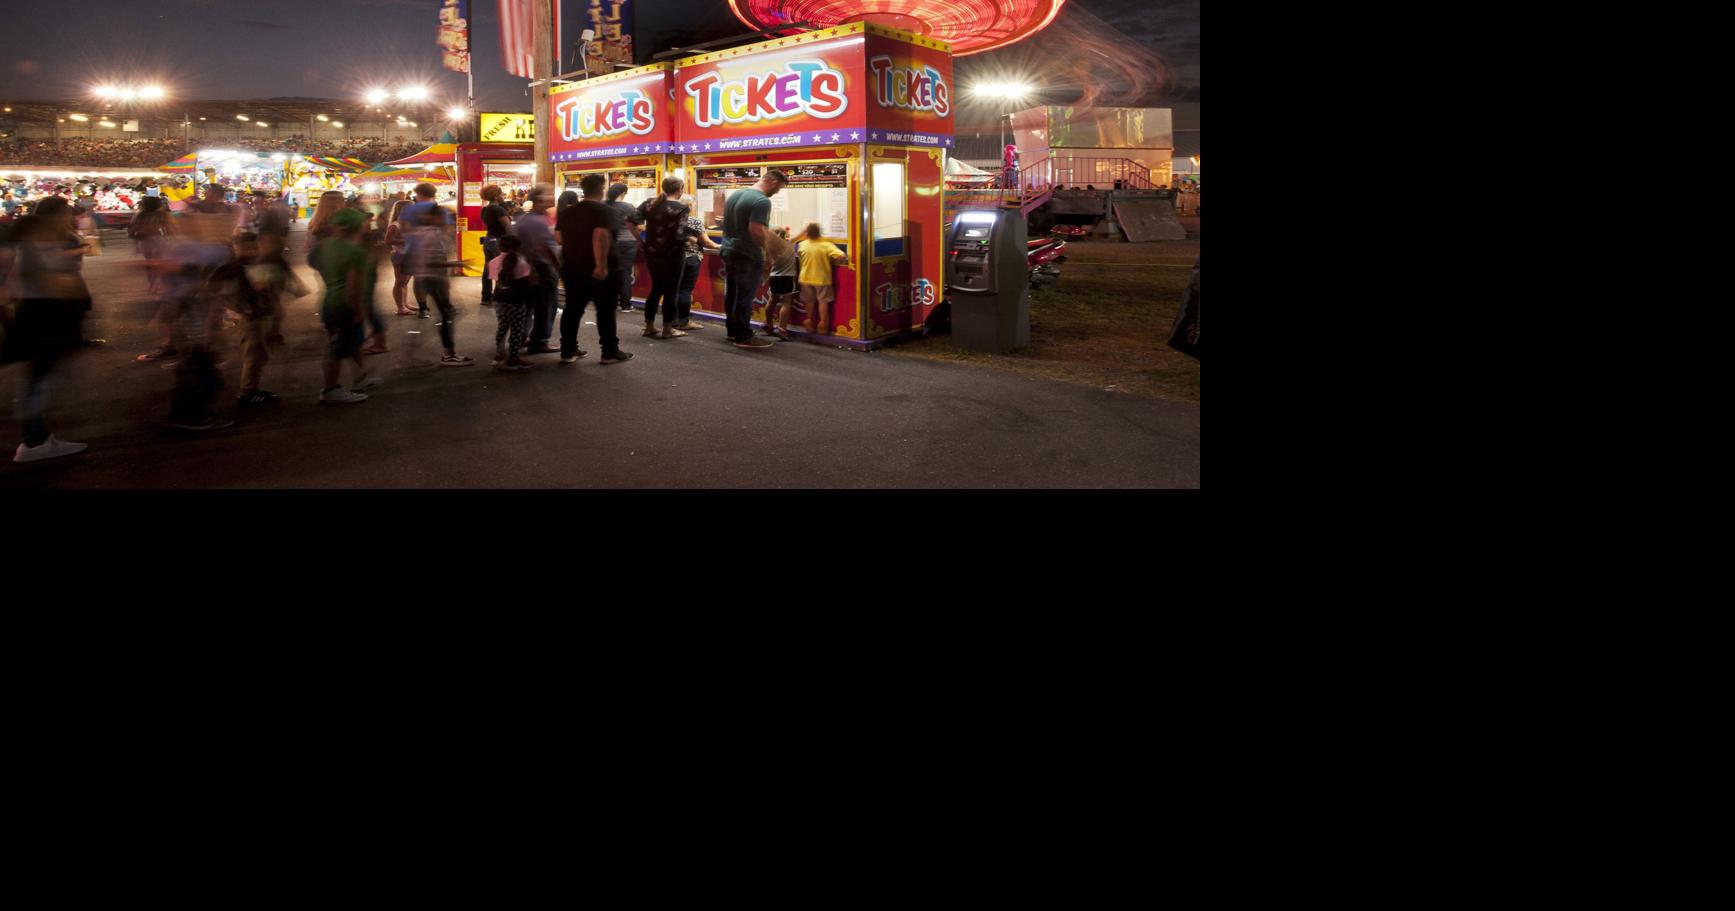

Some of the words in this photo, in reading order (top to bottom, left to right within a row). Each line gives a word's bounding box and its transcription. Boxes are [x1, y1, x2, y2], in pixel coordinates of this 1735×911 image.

[686, 59, 847, 127] TICKETS
[871, 55, 949, 117] TICKETS
[483, 116, 511, 140] FRESH
[557, 90, 653, 141] TICKETS
[719, 136, 801, 148] WWW.STRATES.COM
